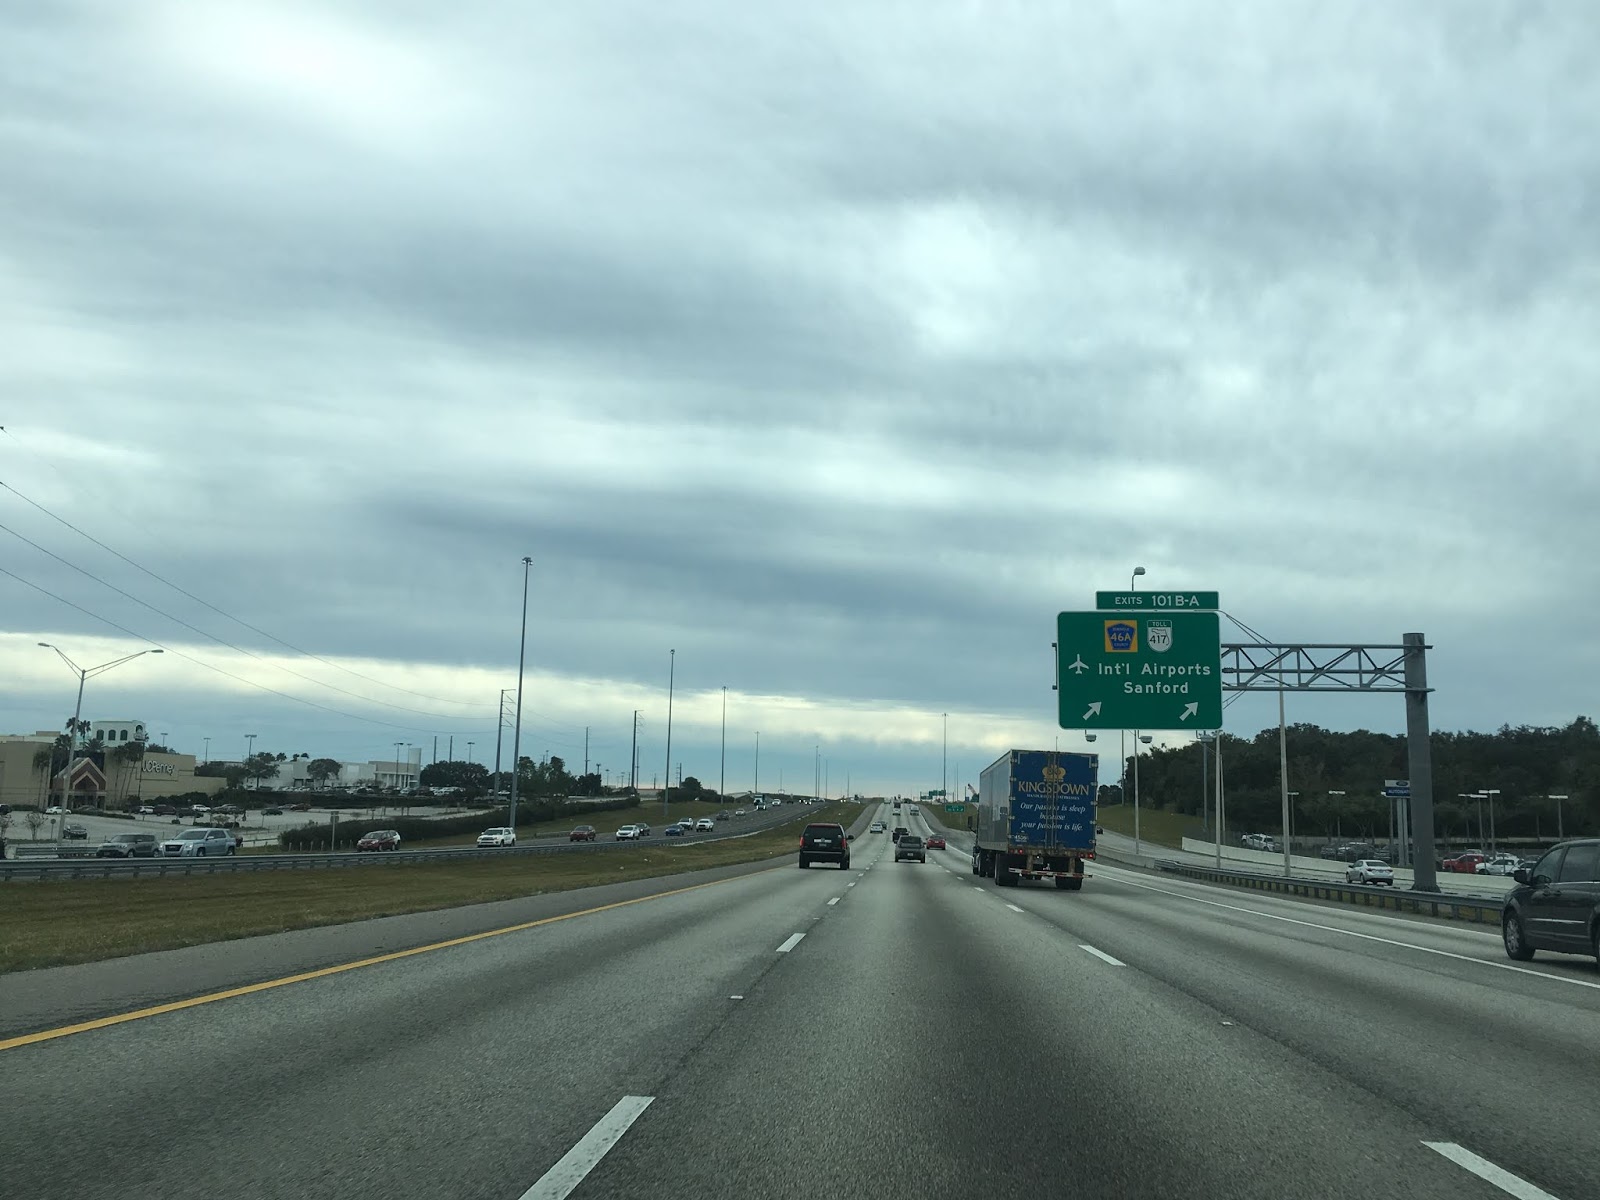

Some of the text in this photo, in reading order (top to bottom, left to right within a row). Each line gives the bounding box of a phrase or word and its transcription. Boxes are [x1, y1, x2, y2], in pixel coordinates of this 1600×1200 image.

[1115, 597, 1142, 605] EXITS
[1110, 632, 1131, 642] 46A
[1149, 635, 1166, 644] 417
[1098, 663, 1211, 677] Int'l Airports
[1124, 682, 1189, 694] Sanford
[1018, 781, 1089, 795] KINGSDOWN
[1020, 802, 1033, 810] Our
[1069, 805, 1086, 814] sleep
